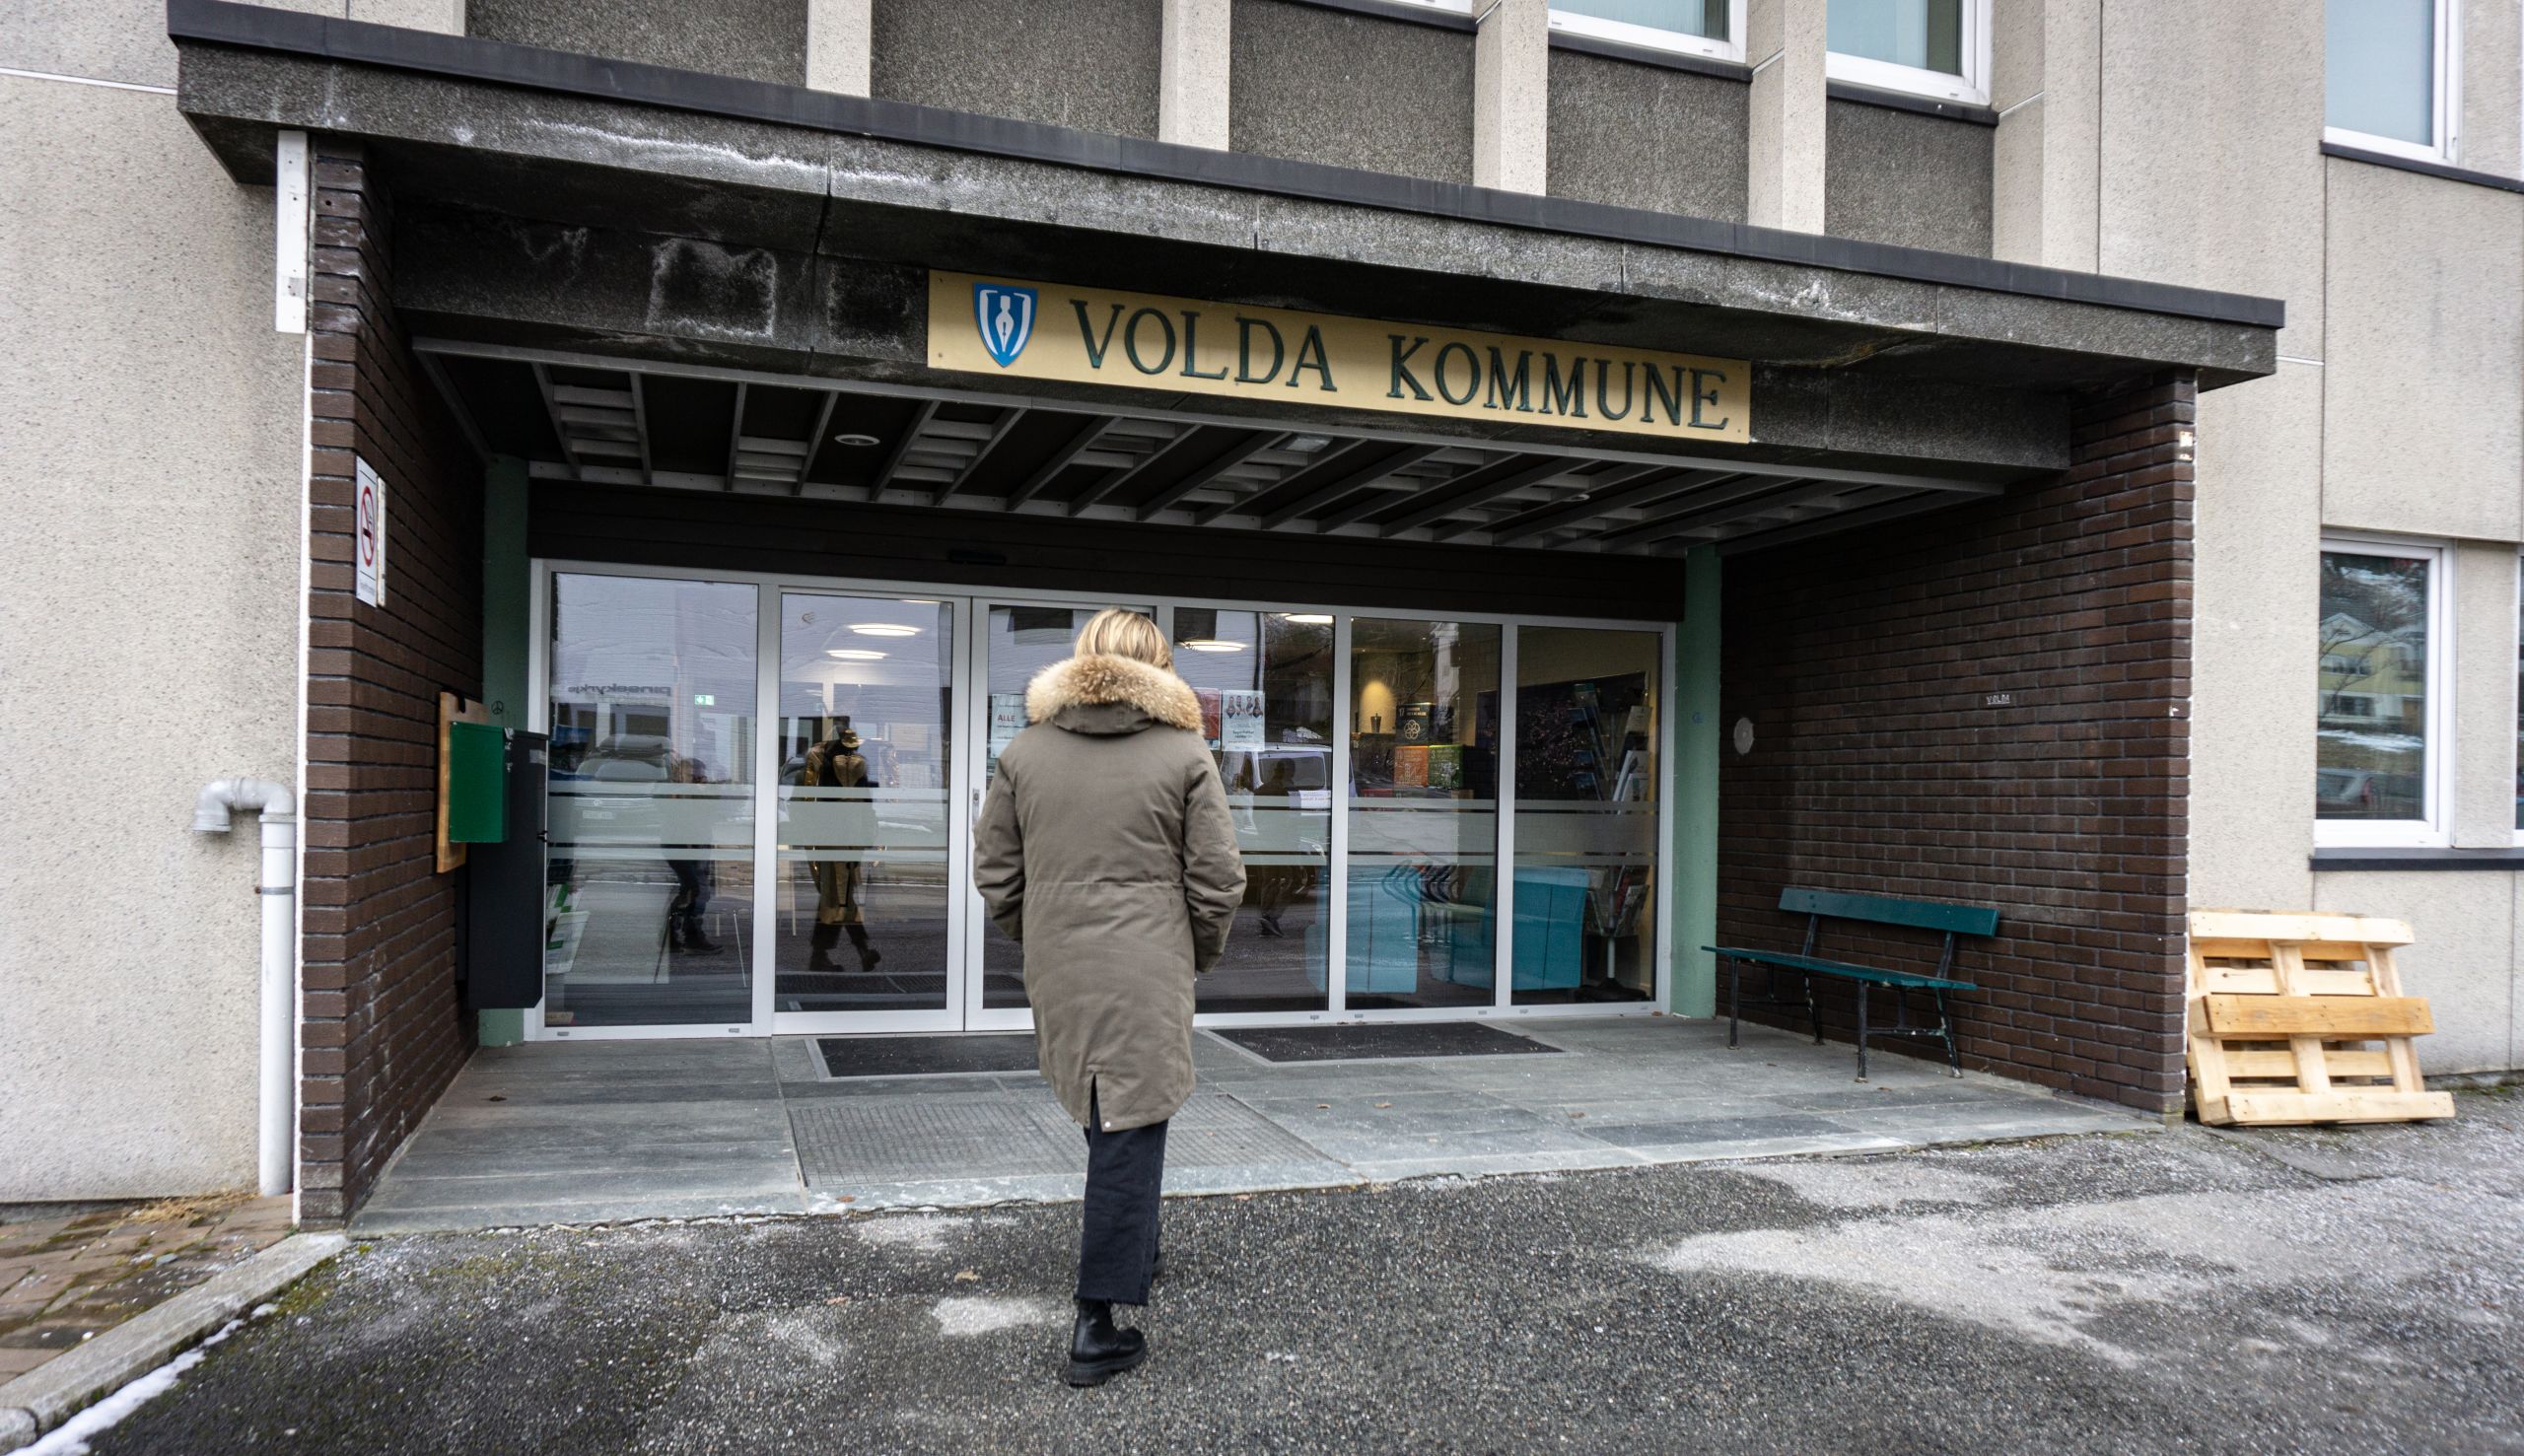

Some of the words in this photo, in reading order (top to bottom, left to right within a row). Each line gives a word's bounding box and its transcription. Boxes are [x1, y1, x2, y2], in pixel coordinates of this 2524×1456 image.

[1069, 298, 1338, 391] VOLDA
[1385, 333, 1730, 430] KOMMUNE
[997, 714, 1016, 723] ALLE
